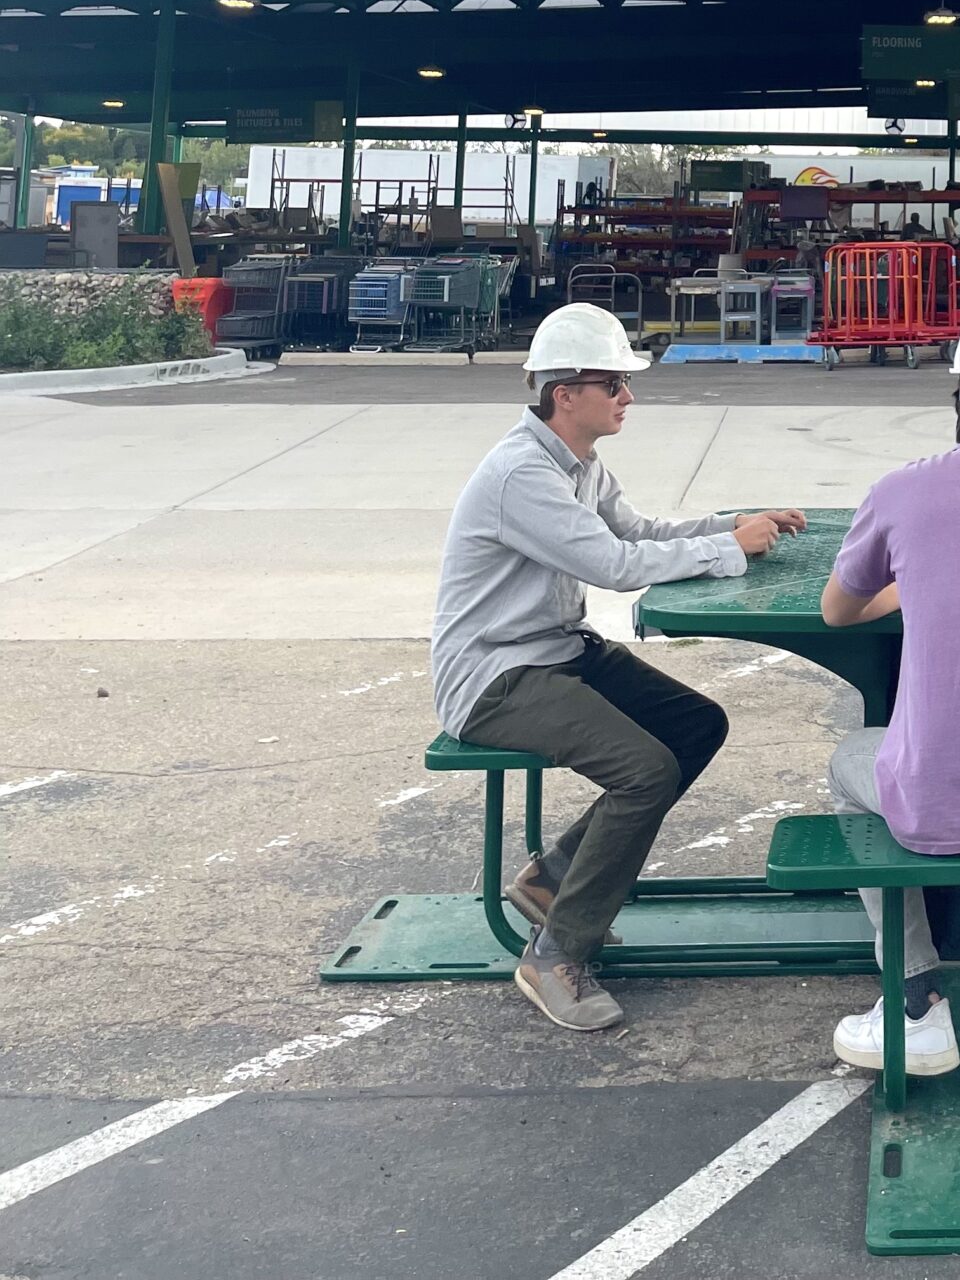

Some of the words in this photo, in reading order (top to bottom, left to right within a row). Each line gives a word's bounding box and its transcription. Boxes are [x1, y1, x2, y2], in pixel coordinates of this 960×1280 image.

[872, 36, 922, 49] FLOORING
[236, 108, 280, 118] PLUMBING
[236, 118, 272, 127] FIXTURES
